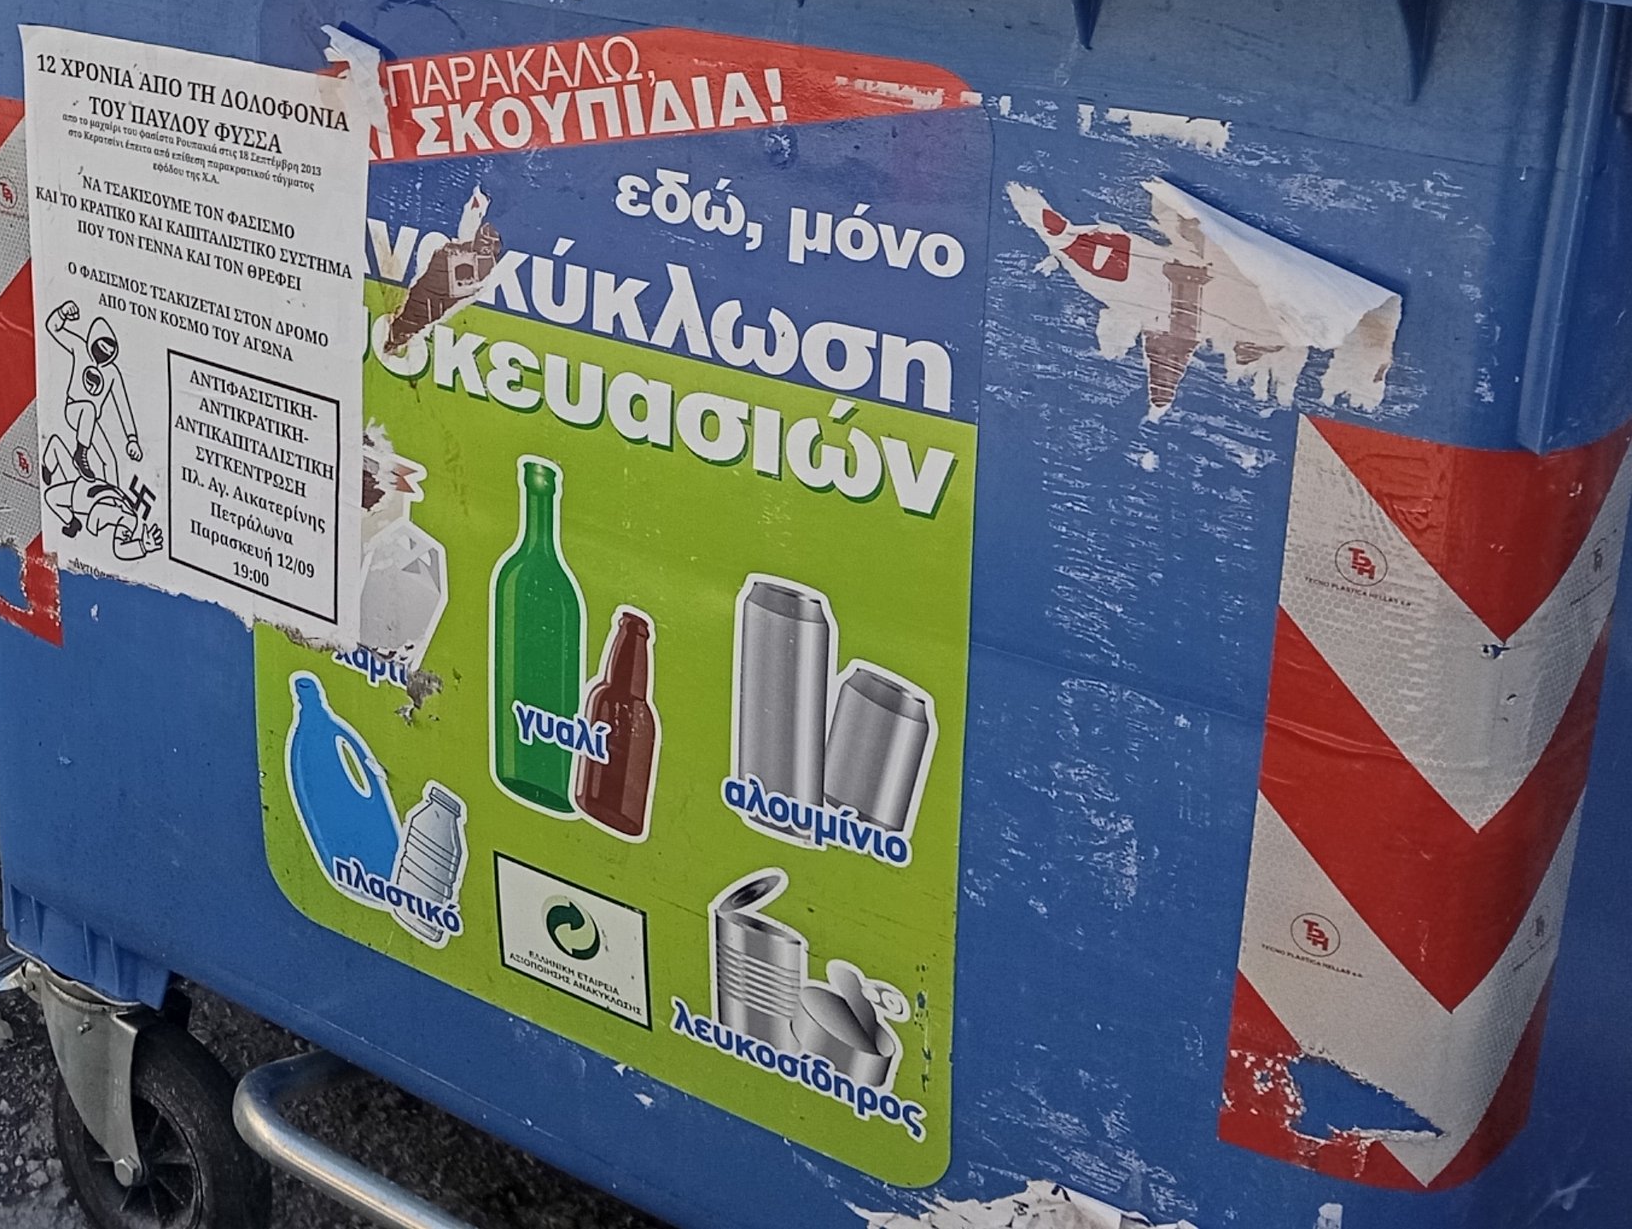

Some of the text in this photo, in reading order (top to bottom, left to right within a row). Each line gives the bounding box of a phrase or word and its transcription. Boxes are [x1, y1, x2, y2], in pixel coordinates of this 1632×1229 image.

[36, 54, 351, 132] 12 ΧΡΟΝΙΑ ΑΠΟ ΤΗ ΔΟΛΟΦΟΝΙΑ
[386, 36, 657, 107] ΠΑΡΑΚΑΛΩ,
[88, 96, 283, 154] ΤΟΥ ΠΑΥΛΟΥ ΦΥΣΣΑ
[414, 68, 788, 158] ΣΚΟΥΠΙΔΙΑ!
[68, 128, 315, 193] στο Κερατσίνι έπειτα από επίθεση παρακρατικού τάγματος
[123, 125, 138, 137] του
[139, 128, 174, 146] φασίστα
[219, 145, 238, 160] στις
[239, 148, 249, 160] 18
[250, 151, 299, 174] Σεπτέμβρη
[301, 162, 322, 177] 2013
[185, 170, 200, 182] της
[35, 186, 353, 280] ΚΑΙ ΤΟ ΚΡΑΤΙΚΟ ΚΑΙ ΚΑΠΙΤΑΛΙΣΤΙΚΟ ΣΥΣΤΗΜΑ
[82, 176, 296, 240] ΝΑ ΤΣΑΚΙΣΟΥΜΕ ΤΟΝ ΦΑΣΙΣΜΟ
[614, 169, 966, 279] εδώ, μόνο
[77, 220, 302, 292] ΠΟΥ ΤΟΝ ΓΕΝΝΑ ΚΑΙ ΤΟΝ ΘΡΕΦΕΙ
[68, 262, 329, 348] Ο ΦΑΣΙΣΜΟΣ ΤΣΑΚΙΖΕΤΑΙ ΣΤΟΝ ΔΡΟΜΟ
[98, 292, 294, 362] ΑΠΟ ΤΟΝ ΚΟΣΜΟ ΤΟΥ ΑΓΩΝΑ
[190, 370, 318, 421] ΑΝΤΙΦΑΣΙΣΤΙΚΗ-
[199, 398, 309, 444] ΑΝΤΙΚΡΑΤΙΚΗ-
[363, 304, 955, 518] σκευασιών
[174, 415, 335, 481] ΑΝΤΙΚΑΠΙΤΑΛΙΣΤΙΚΗ
[195, 446, 307, 498] ΣΥΓΚΕΝΤΡΩΣΗ
[181, 467, 326, 534] Πλ. Αγ. Αικατερίνης
[210, 501, 294, 545] Πετράλωνα
[190, 520, 315, 579] Παρασκευή 12/09
[233, 561, 270, 588] 19:00
[515, 706, 609, 760] γυαλί
[725, 779, 908, 863] αλουμίνιο
[336, 858, 461, 933] πλαστικό
[509, 952, 643, 1017] ΑΞΙΟΠΟΙΗΣΗΣ ΑΝΑΚΥΚΛΩΣΗΣ
[529, 950, 620, 996] ΕΛΛΗΝΙΚΗ ΕΤΑΙΡΕΙΑ
[673, 1002, 924, 1138] λευκοσίδηρος
